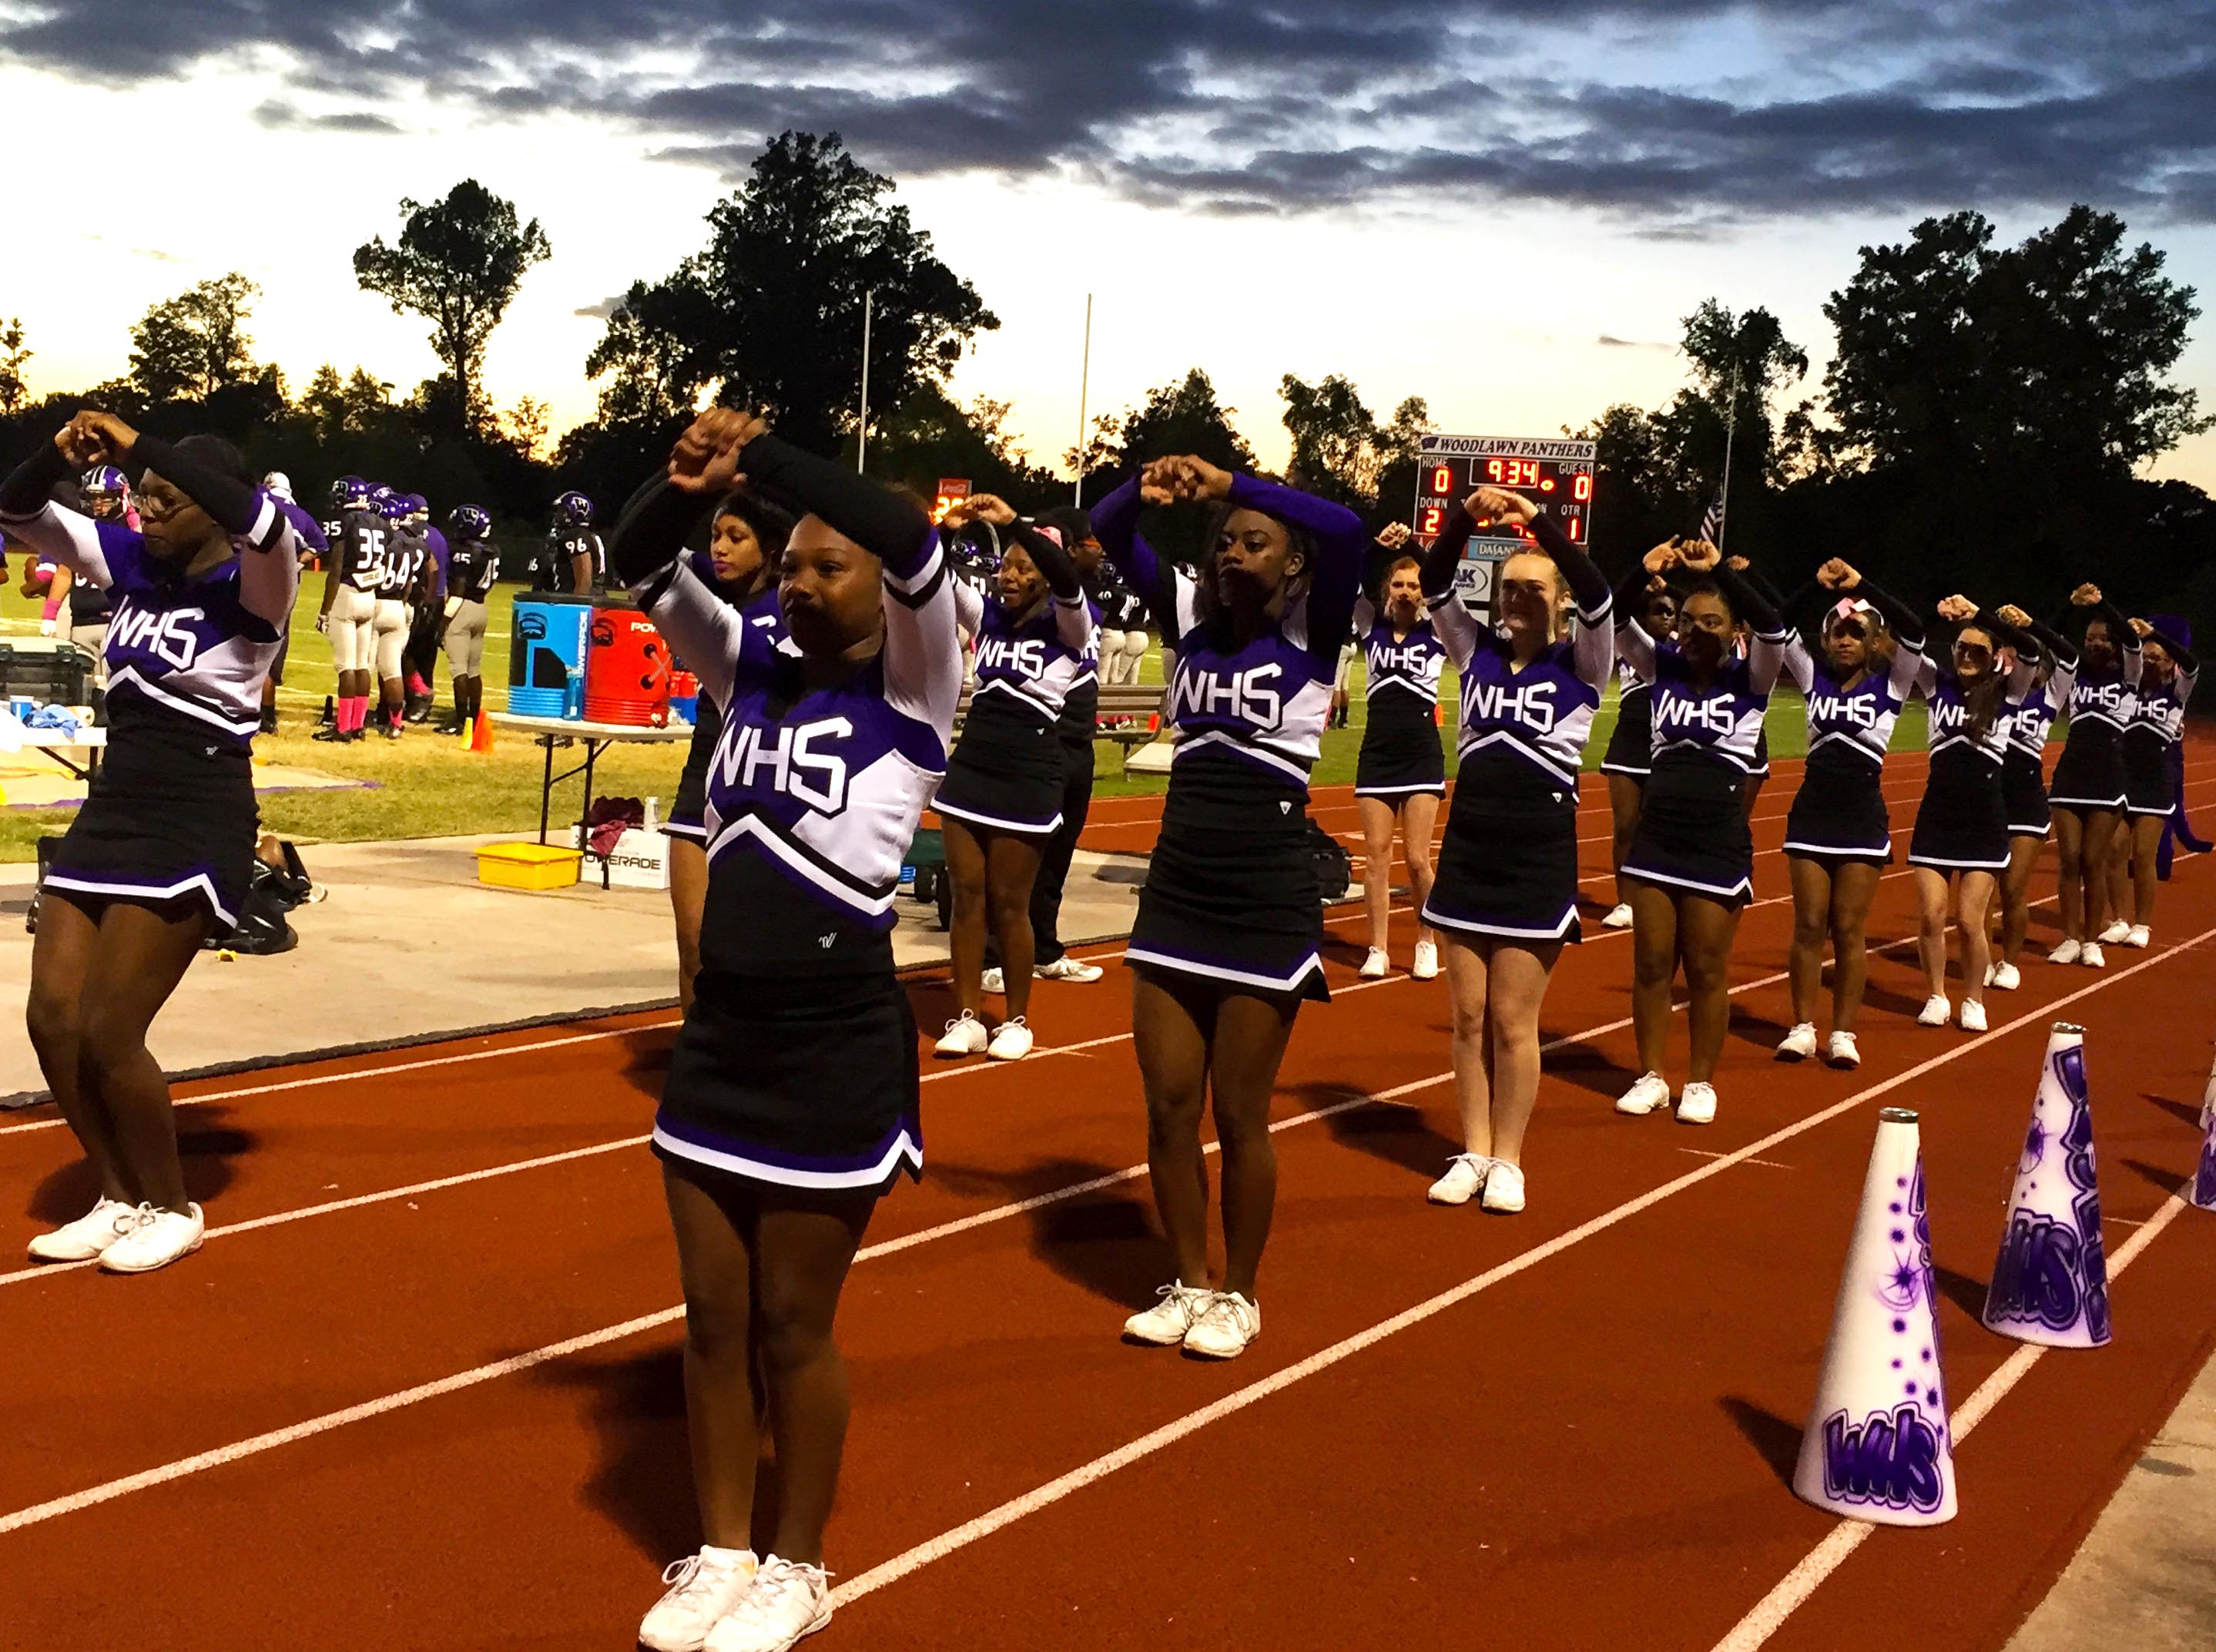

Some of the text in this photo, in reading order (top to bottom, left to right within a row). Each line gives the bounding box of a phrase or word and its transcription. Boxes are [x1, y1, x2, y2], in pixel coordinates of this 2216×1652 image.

[1440, 438, 1594, 457] WOODLAWN PANTHERS
[1422, 456, 1449, 468] HOME
[1558, 463, 1592, 475] GUEST
[1434, 469, 1449, 492] 0
[1574, 476, 1589, 500] 0
[1420, 497, 1448, 509] DOWN
[323, 521, 342, 536] 35
[1425, 509, 1440, 533] 2
[1571, 518, 1577, 540] 1
[357, 528, 385, 569] 35
[565, 538, 587, 554] 96
[104, 595, 205, 671] WHS
[974, 634, 1046, 680] WHS
[1370, 641, 1426, 676] WHS
[1168, 656, 1282, 730] WHS
[1462, 674, 1557, 733] WHS
[2070, 682, 2121, 709] WHS
[1655, 689, 1735, 736] WHS
[1809, 692, 1876, 729] WHS
[705, 708, 853, 813] WHS
